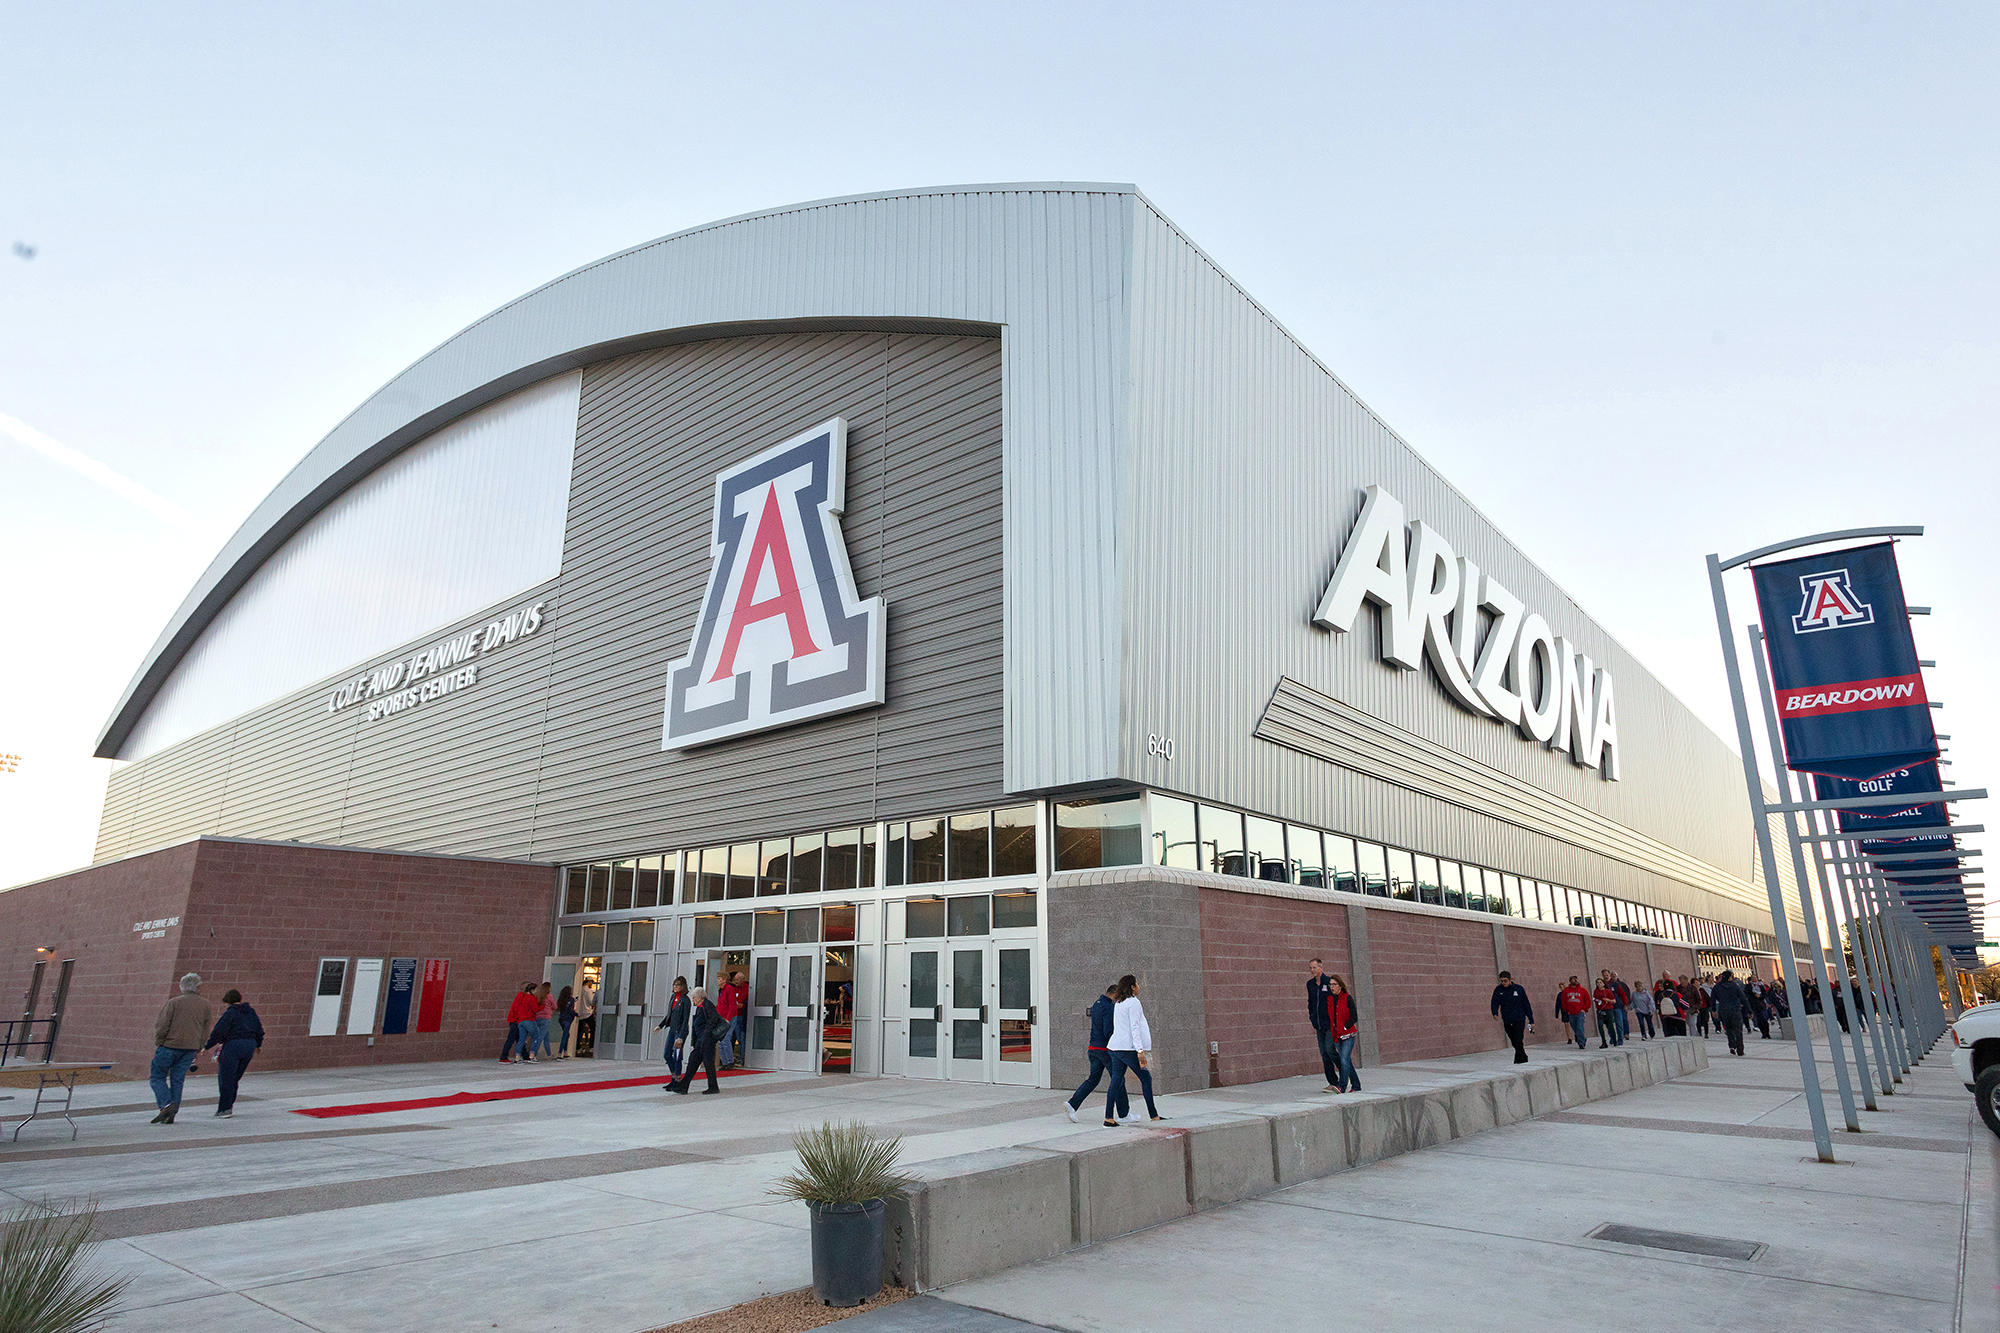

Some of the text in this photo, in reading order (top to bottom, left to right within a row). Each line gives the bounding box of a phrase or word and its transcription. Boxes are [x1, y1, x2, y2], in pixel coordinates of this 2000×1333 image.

[662, 416, 887, 751] A
[1792, 568, 1875, 635] A
[328, 602, 546, 712] COLE AND JEANNIE DAVIS
[1313, 484, 1620, 782] ARIZONA
[368, 664, 479, 722] SPORTS CENTER
[1147, 732, 1174, 760] 640
[1858, 779, 1894, 793] GOLF
